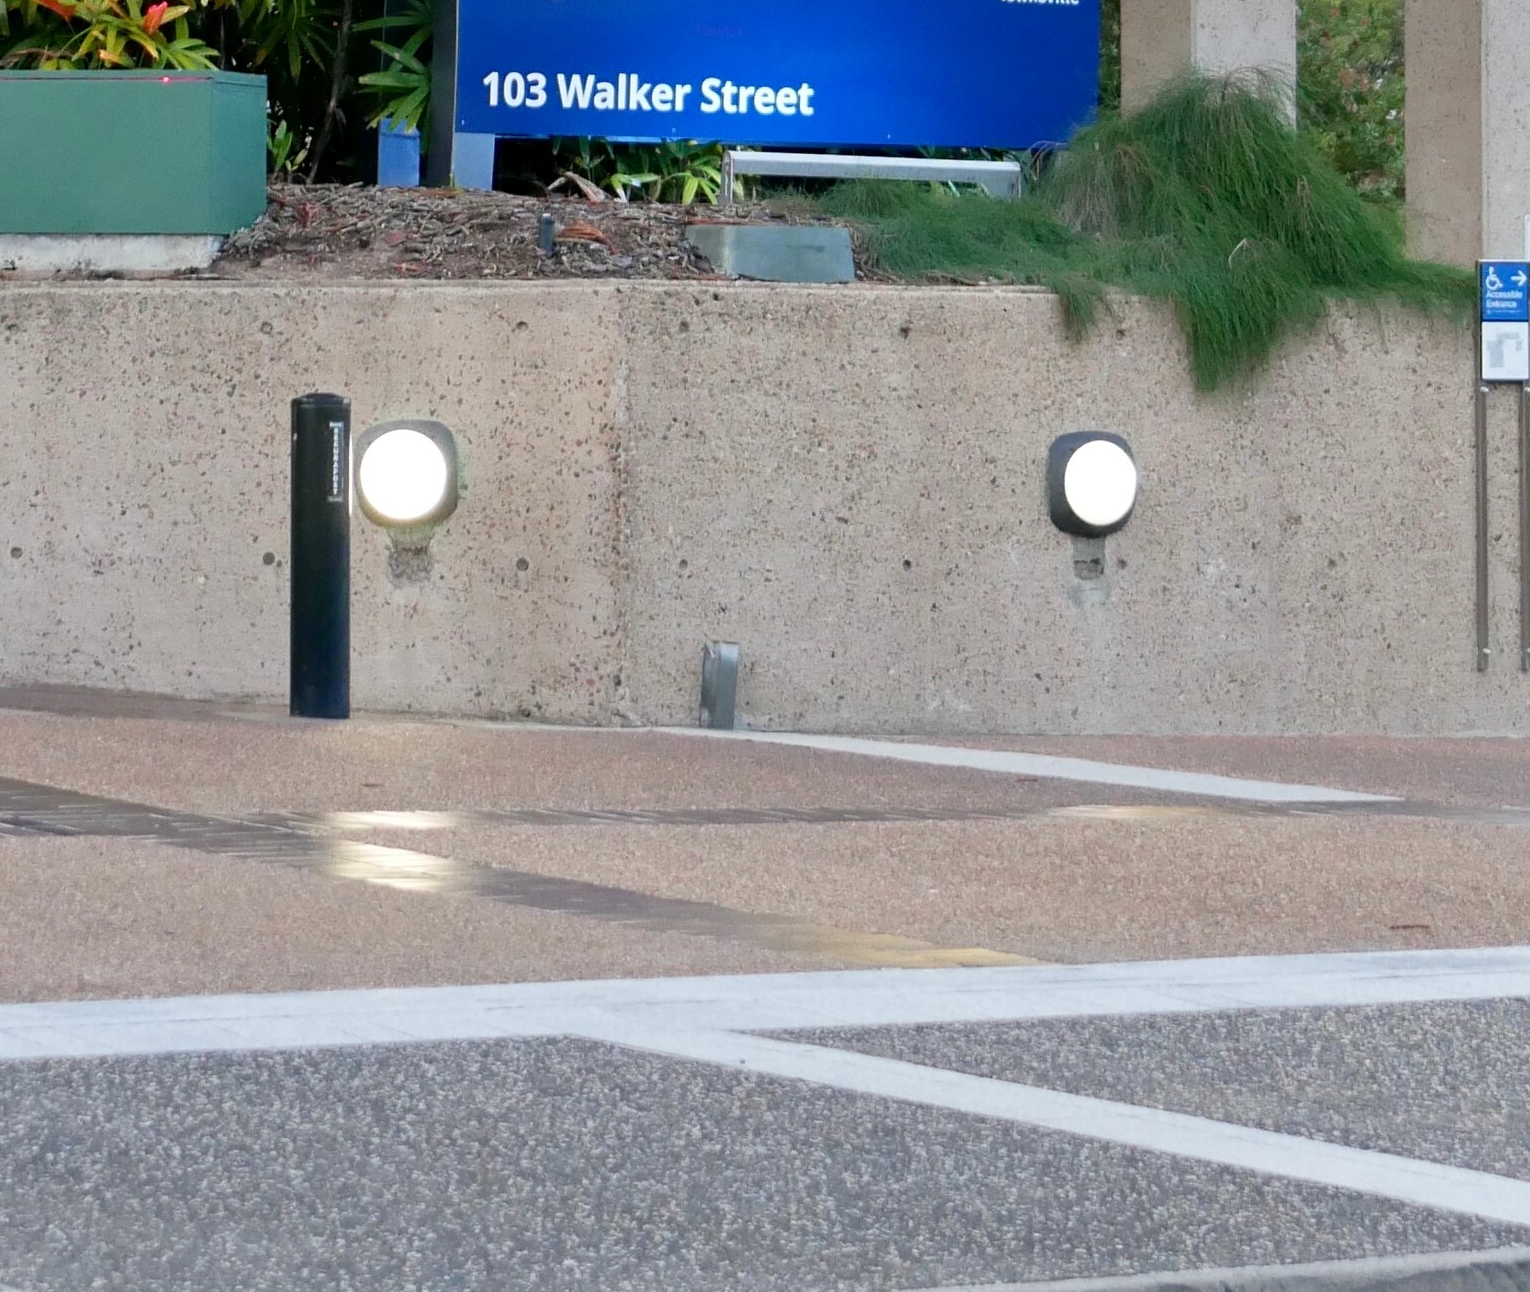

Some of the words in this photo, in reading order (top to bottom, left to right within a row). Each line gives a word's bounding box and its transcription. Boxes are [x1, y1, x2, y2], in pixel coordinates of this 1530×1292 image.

[482, 71, 547, 107] 103
[557, 73, 691, 112] Walker
[700, 77, 815, 116] Street
[1486, 289, 1523, 299] Accessible
[1486, 299, 1517, 308] Entrance
